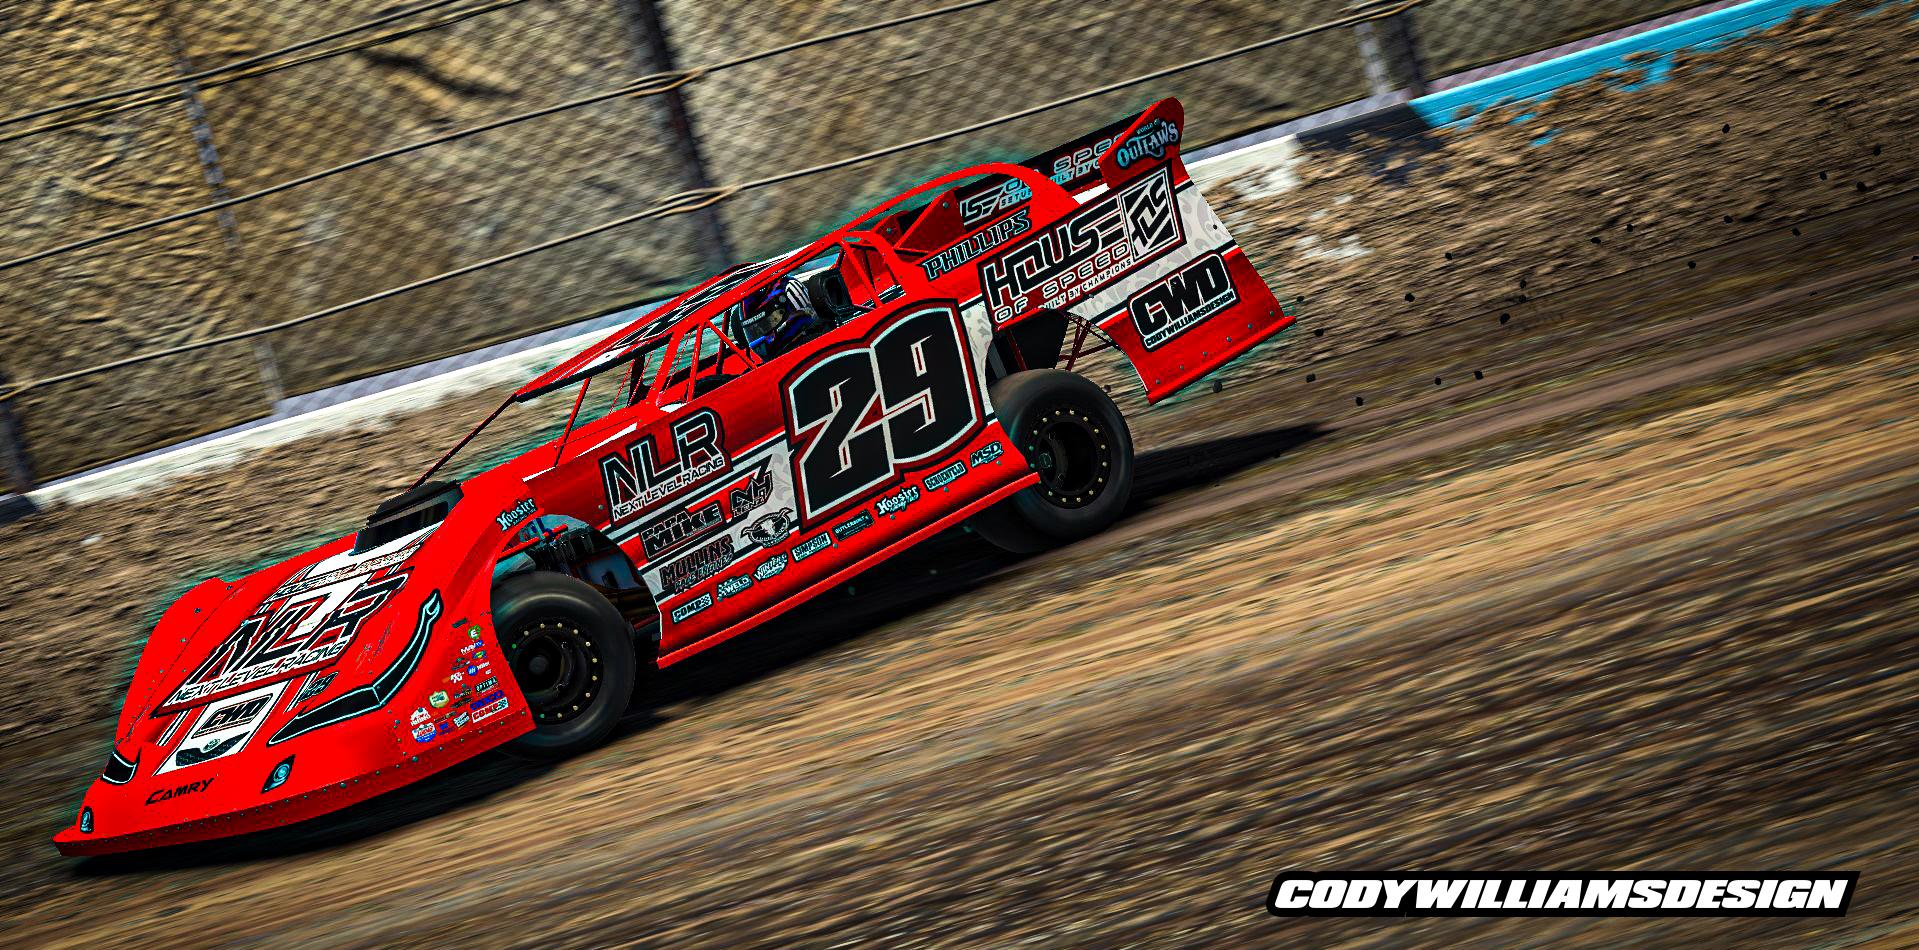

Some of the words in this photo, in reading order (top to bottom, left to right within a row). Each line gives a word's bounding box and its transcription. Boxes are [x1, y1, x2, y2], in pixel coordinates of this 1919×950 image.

[1117, 120, 1179, 167] OUTLAWS
[922, 210, 1031, 280] PHILLIPS
[983, 194, 1128, 311] HOUSE
[995, 297, 1029, 322] OF
[1043, 242, 1130, 298] SPEED
[1040, 294, 1067, 309] UILT
[1068, 287, 1081, 298] BY
[1081, 258, 1133, 291] CHAMPIONS
[1130, 254, 1230, 336] CWD
[789, 307, 977, 520] 29
[603, 411, 720, 506] NLR
[970, 442, 1003, 467] MSD
[496, 498, 535, 531] Hoosier
[641, 510, 690, 540] PAPA
[642, 504, 722, 558] MIKE
[660, 535, 734, 590] MULLINS
[794, 534, 829, 556] SIMPSON
[673, 598, 703, 621] COMP
[725, 576, 750, 594] WELD
[186, 573, 408, 686] NLR
[145, 777, 215, 806] CAMRY
